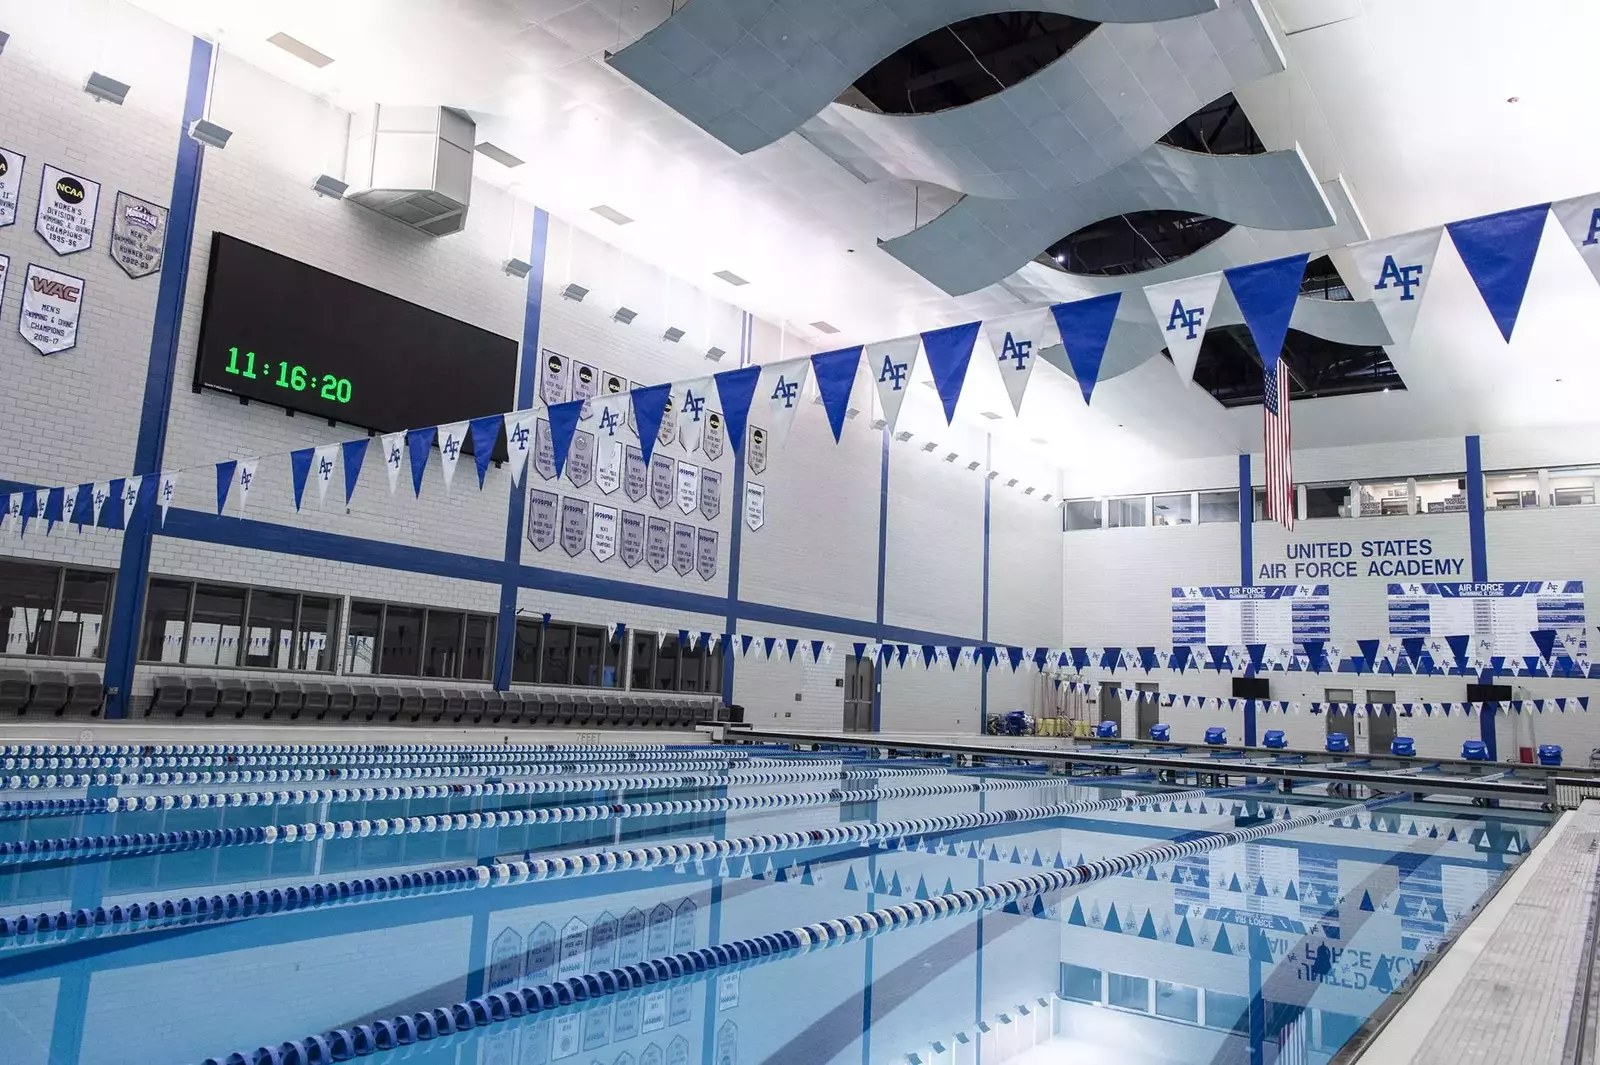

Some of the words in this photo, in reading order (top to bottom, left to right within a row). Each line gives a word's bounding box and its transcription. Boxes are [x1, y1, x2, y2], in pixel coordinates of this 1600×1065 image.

[57, 183, 84, 199] NCAA
[47, 206, 76, 222] DIVISION
[54, 200, 82, 216] WOMEN'S
[46, 224, 82, 240] CHAMPIONS
[49, 233, 77, 248] 1995-96
[130, 230, 148, 241] MEN'S
[120, 245, 154, 261] RUNNER-UP
[1374, 255, 1423, 301] AF
[31, 276, 80, 303] WAC
[24, 309, 48, 322] SWIMMING
[41, 304, 60, 314] MEN'S
[1166, 299, 1204, 340] AF
[30, 322, 65, 336] CHAMPIONS
[999, 332, 1032, 370] AF
[879, 355, 908, 391] AF
[771, 375, 798, 408] AF
[681, 389, 705, 422] AF
[599, 406, 619, 436] AF
[443, 434, 460, 460] AF
[510, 422, 530, 450] AF
[388, 443, 400, 468] AF
[241, 468, 252, 490] AF
[319, 456, 333, 480] AF
[1286, 542, 1353, 560] UNITED
[1361, 538, 1432, 558] STATES
[1258, 563, 1287, 579] AIR
[1295, 561, 1358, 578] FORCE
[1367, 558, 1464, 577] ACADEMY
[1242, 586, 1266, 594] FORCE
[1458, 584, 1472, 592] AIR
[1474, 583, 1505, 592] FORCE
